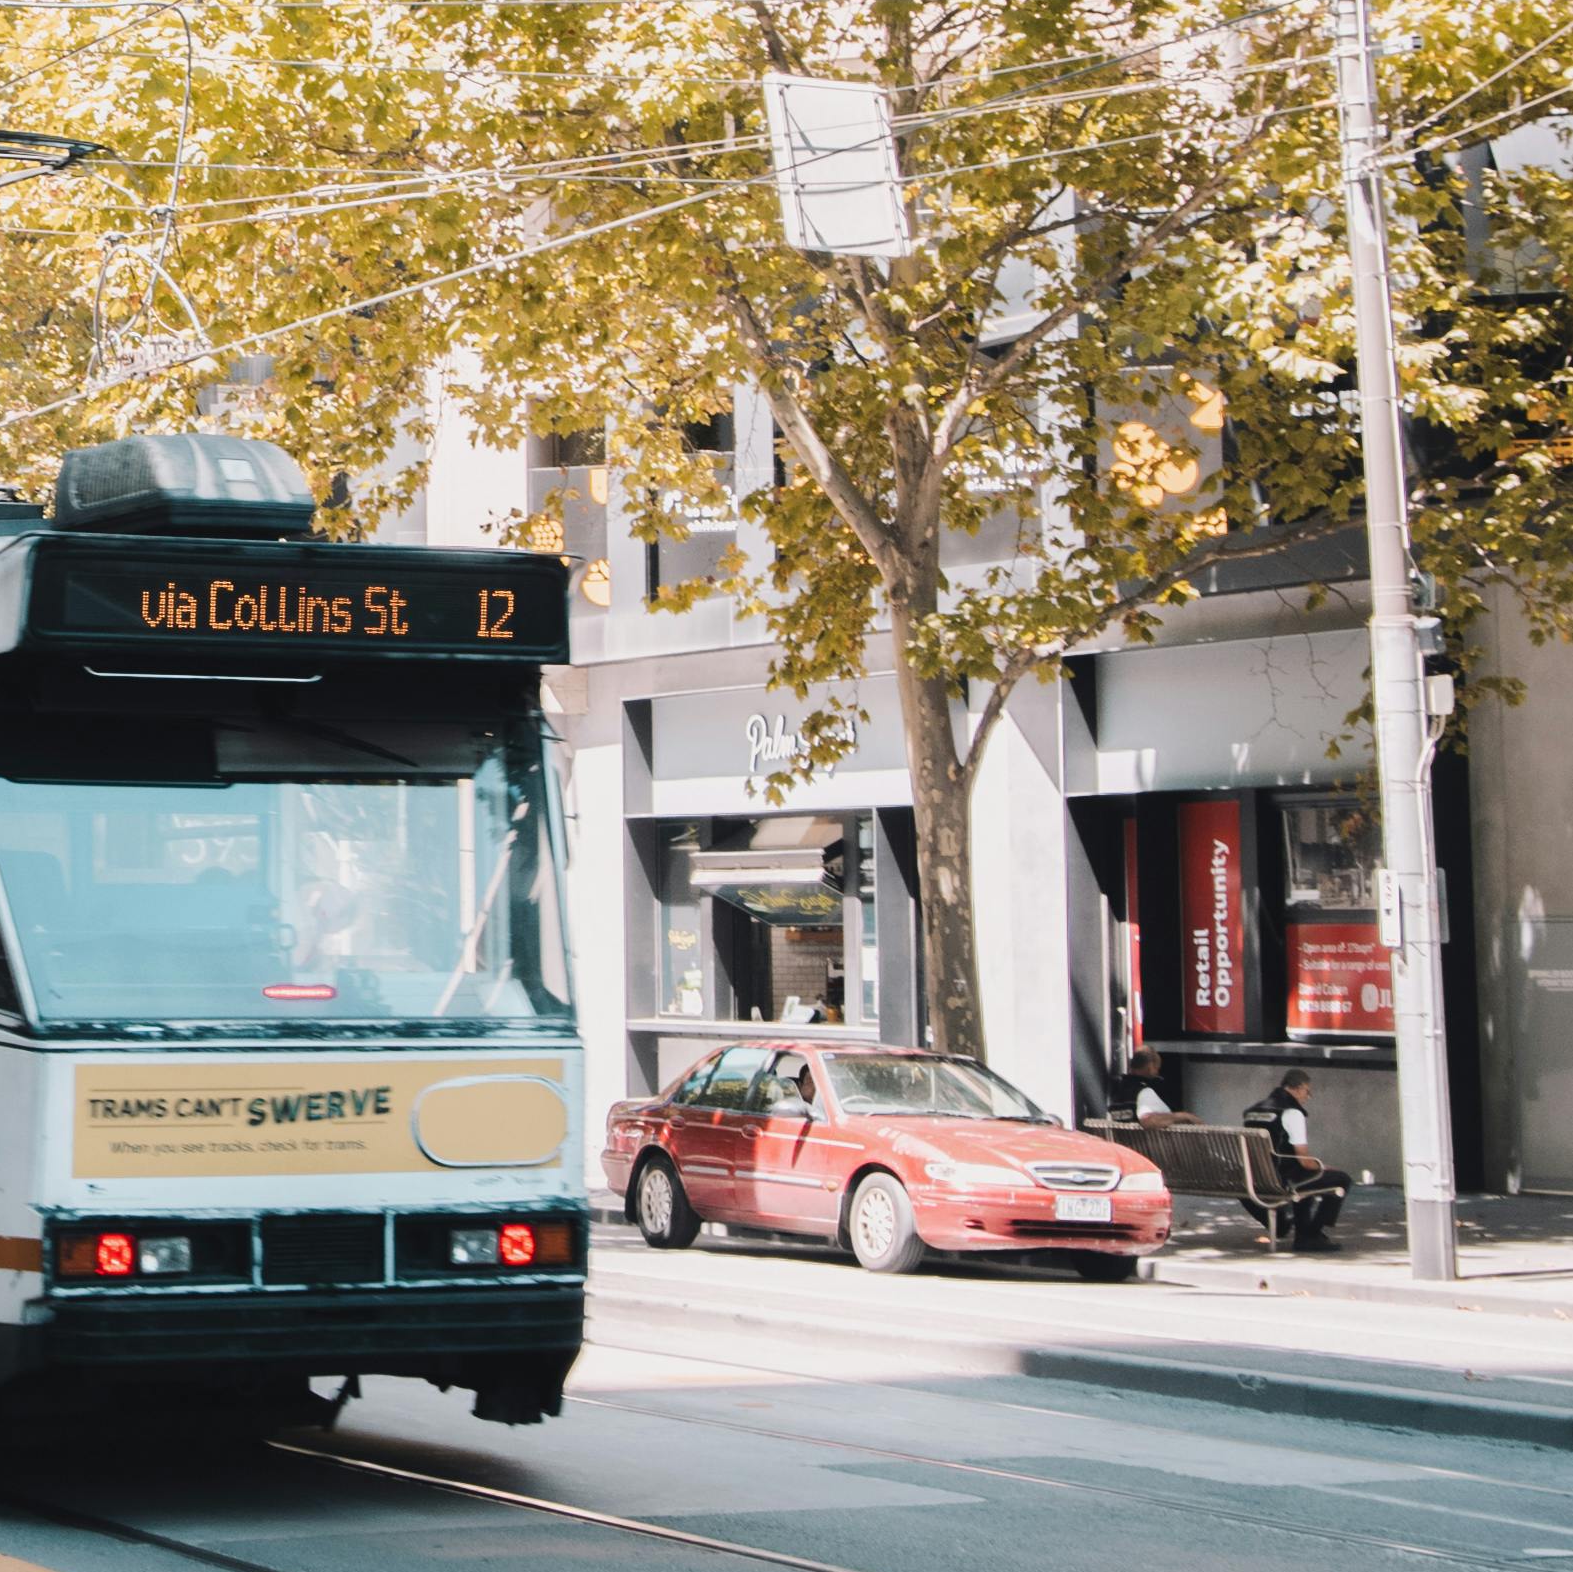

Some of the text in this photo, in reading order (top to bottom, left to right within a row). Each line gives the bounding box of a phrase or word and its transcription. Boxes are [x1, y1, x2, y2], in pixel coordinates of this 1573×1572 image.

[141, 580, 409, 635] via Collins St
[476, 588, 515, 639] 12
[1210, 838, 1233, 1008] Opportunity
[1193, 928, 1212, 1008] Retail
[88, 1085, 392, 1127] TRAMS CAN'T SWERVE
[108, 1139, 148, 1154] When
[152, 1143, 177, 1157] you
[180, 1141, 206, 1154] see
[259, 1138, 298, 1152] check
[302, 1138, 320, 1151] for
